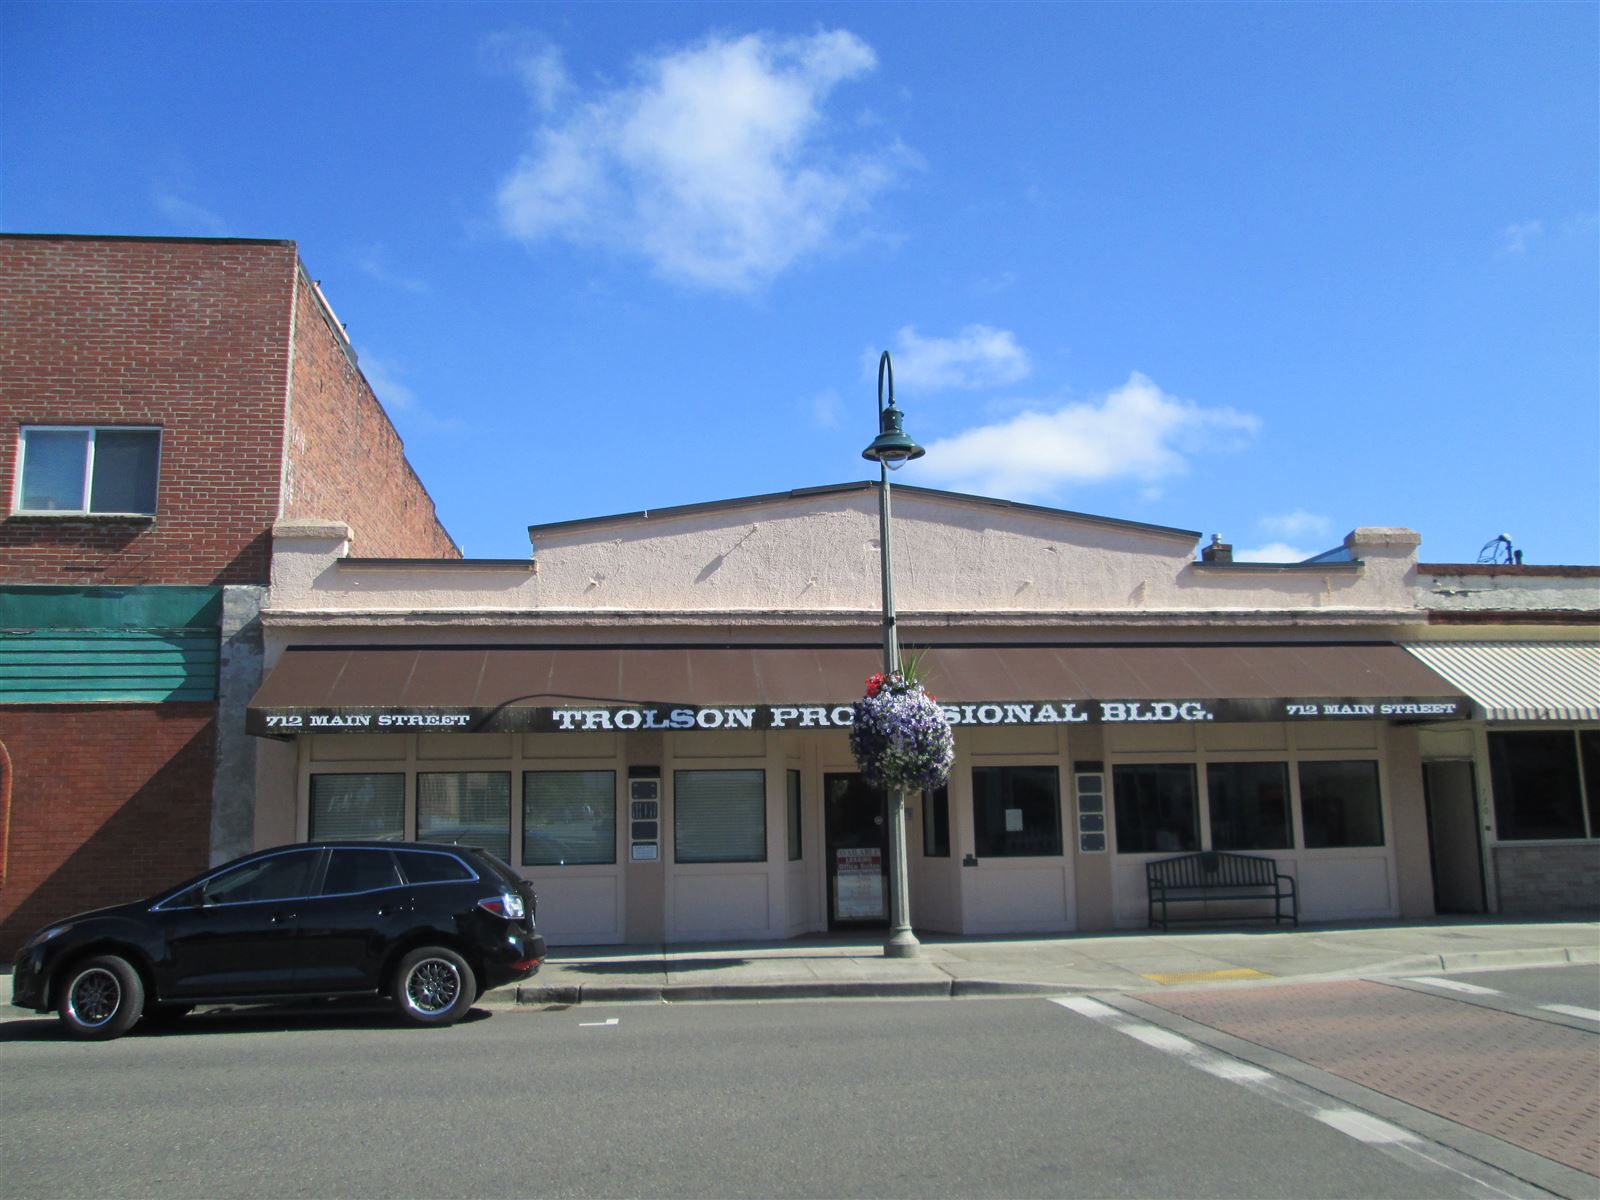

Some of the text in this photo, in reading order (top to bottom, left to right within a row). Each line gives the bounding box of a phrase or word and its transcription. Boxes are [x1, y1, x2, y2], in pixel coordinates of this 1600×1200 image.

[552, 708, 756, 729] TROLSON
[1100, 702, 1214, 722] BLDG.
[1286, 703, 1457, 715] 712 MAIN STREET
[266, 714, 470, 727] 712 MAIN STREET
